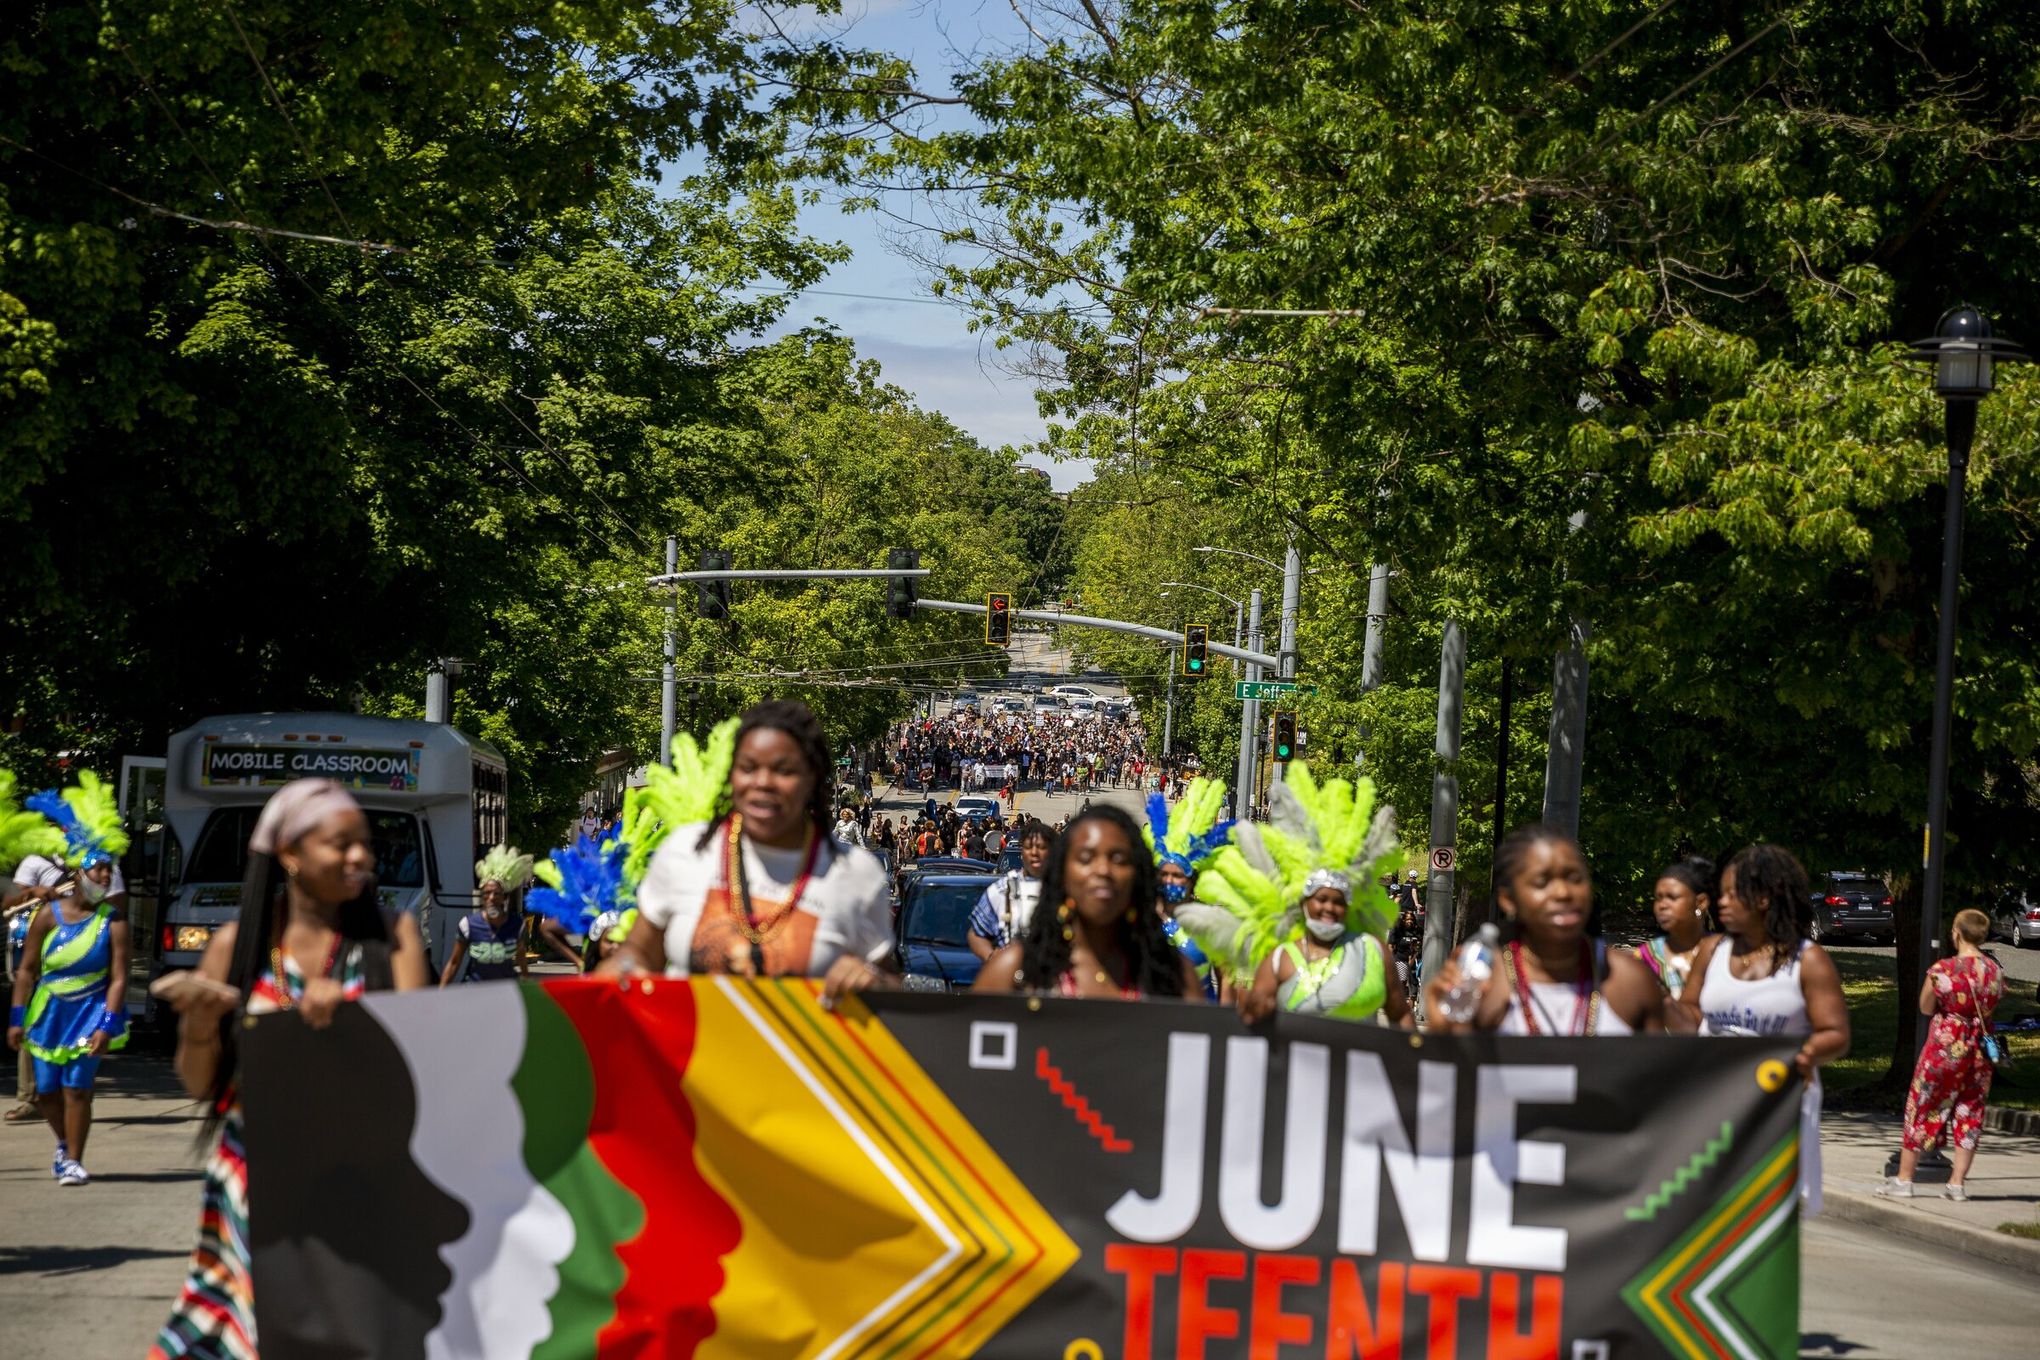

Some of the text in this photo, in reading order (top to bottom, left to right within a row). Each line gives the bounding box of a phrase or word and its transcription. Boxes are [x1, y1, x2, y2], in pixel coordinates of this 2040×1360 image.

[1242, 684, 1251, 698] E
[211, 752, 409, 774] MOBILE CLASSROOM
[1105, 1032, 1577, 1271] JUNE
[1104, 1243, 1564, 1360] TEENTH
